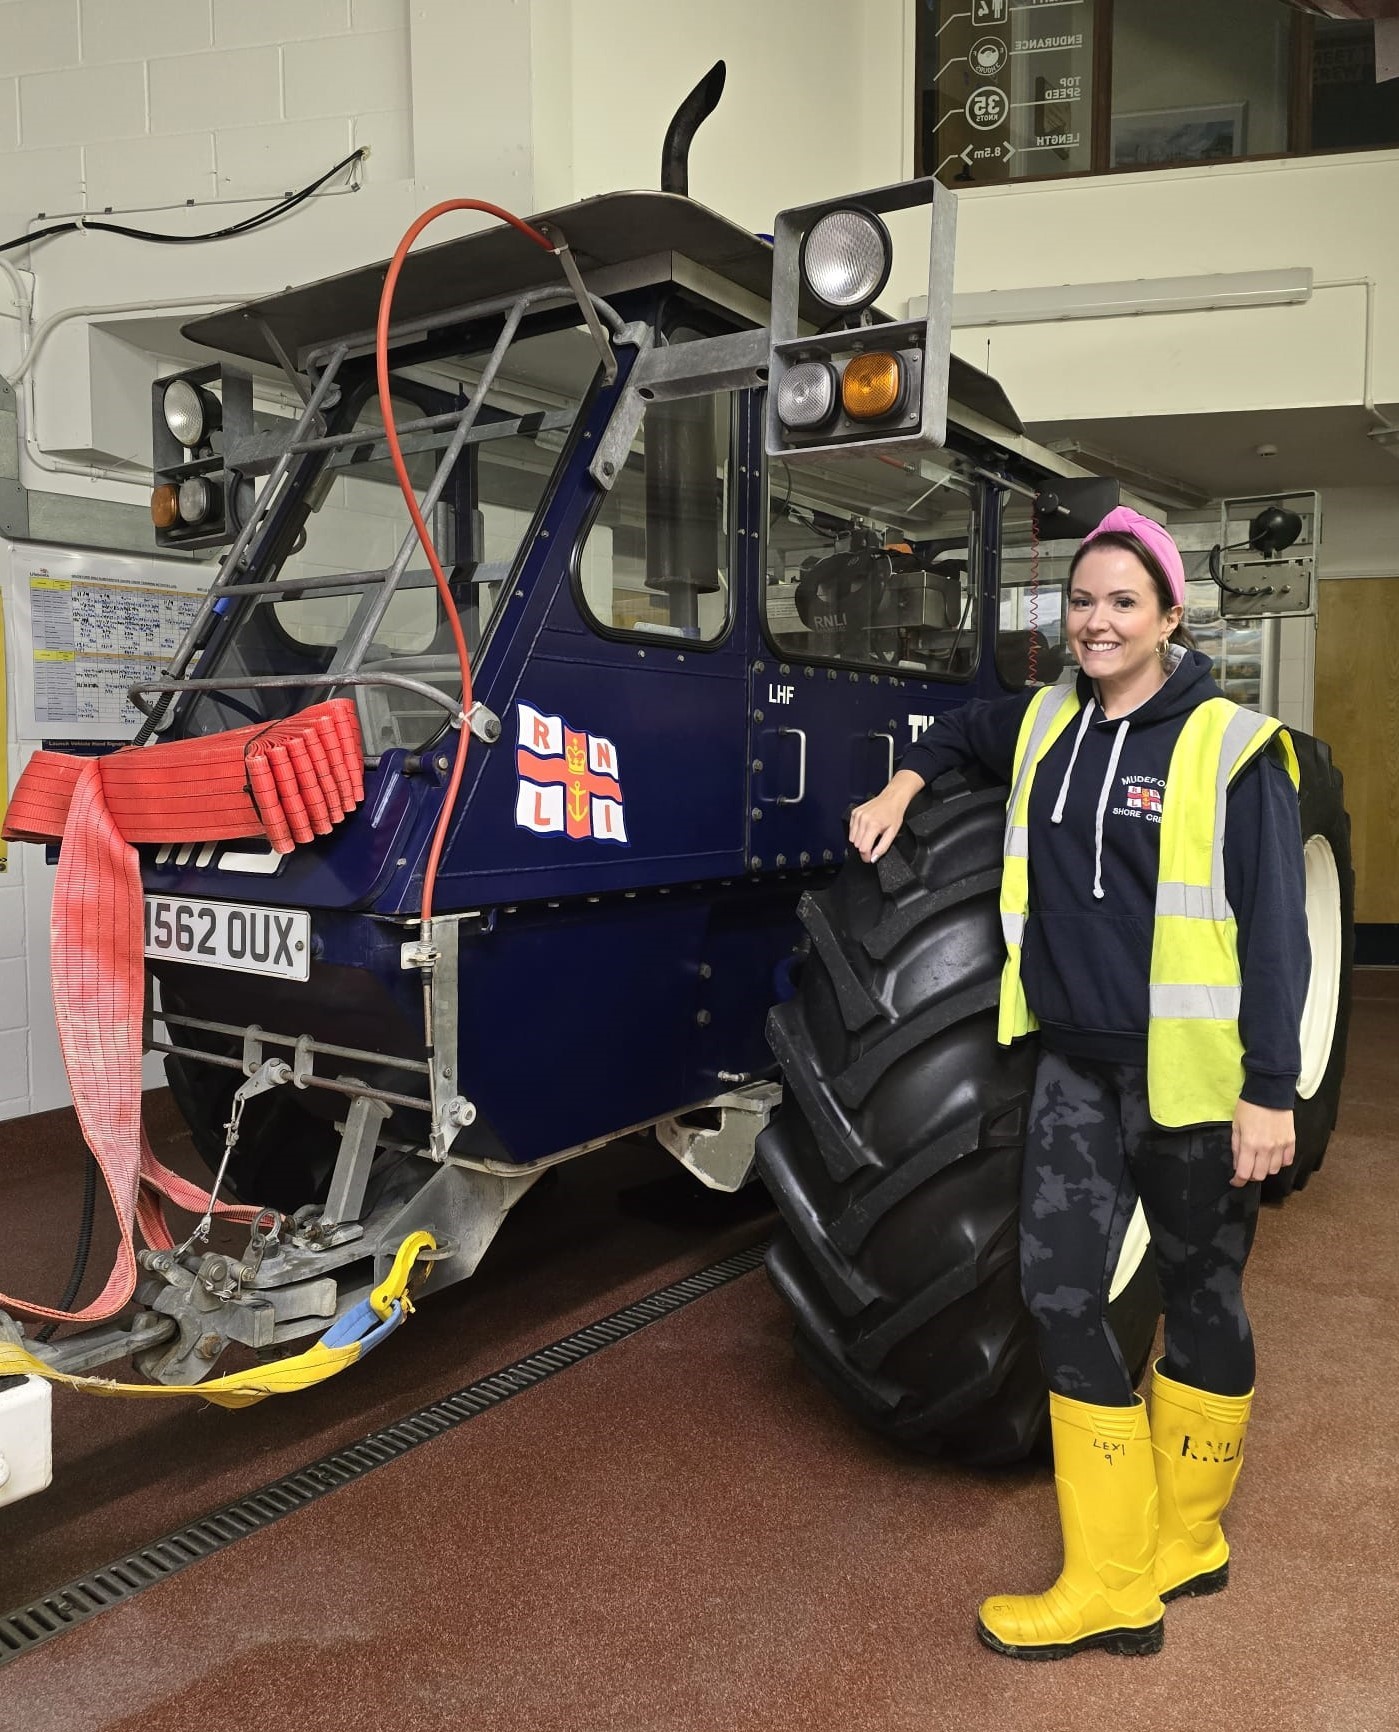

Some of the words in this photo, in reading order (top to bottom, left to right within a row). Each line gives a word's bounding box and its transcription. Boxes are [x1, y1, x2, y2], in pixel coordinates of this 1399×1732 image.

[813, 612, 847, 629] RNLI
[769, 683, 795, 705] LHF
[1121, 776, 1167, 789] MUDEFO
[1112, 807, 1142, 818] SHORE
[1093, 1438, 1126, 1456] LEXI
[1104, 1454, 1113, 1467] 9
